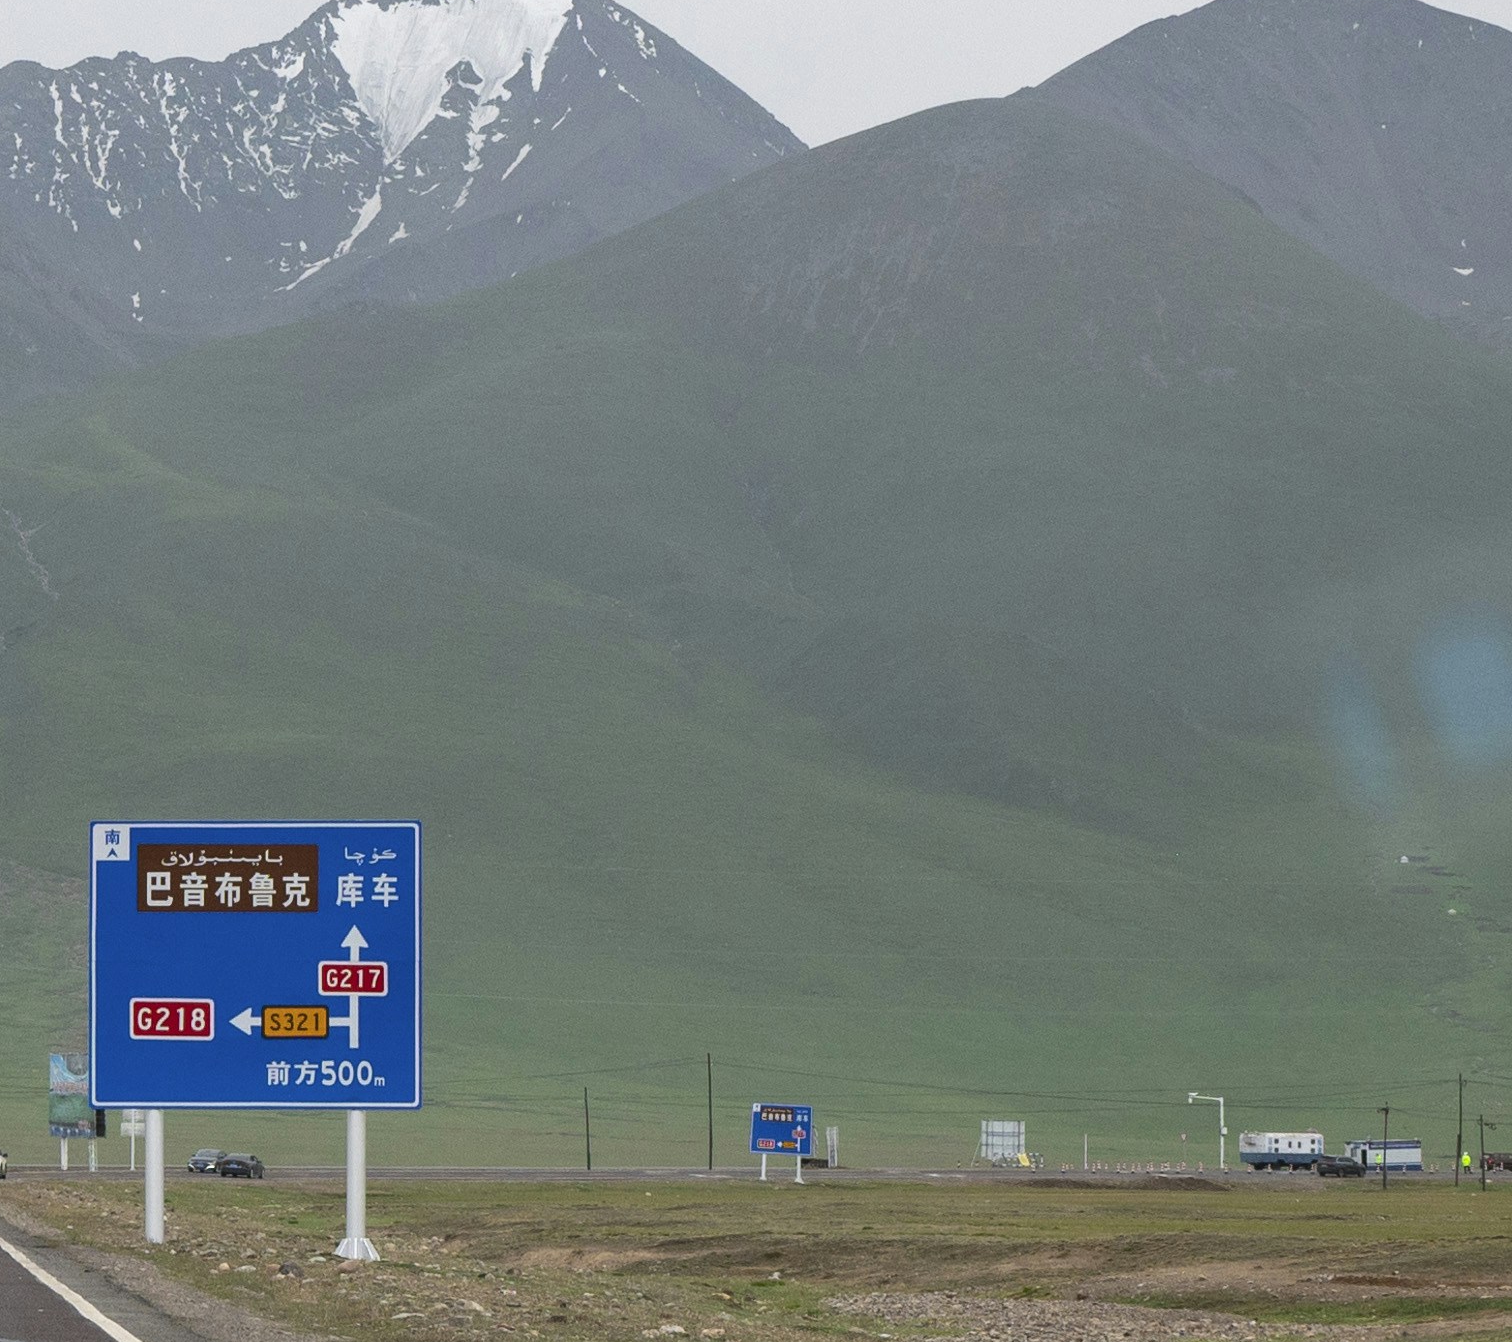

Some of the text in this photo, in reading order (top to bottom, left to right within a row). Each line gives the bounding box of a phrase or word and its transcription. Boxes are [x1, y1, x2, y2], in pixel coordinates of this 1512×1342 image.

[105, 829, 120, 845] 南
[145, 871, 311, 908] 巴音布鲁克
[335, 872, 399, 908] 库车
[325, 969, 382, 989] G217
[136, 1007, 207, 1032] G218
[269, 1012, 322, 1032] S321
